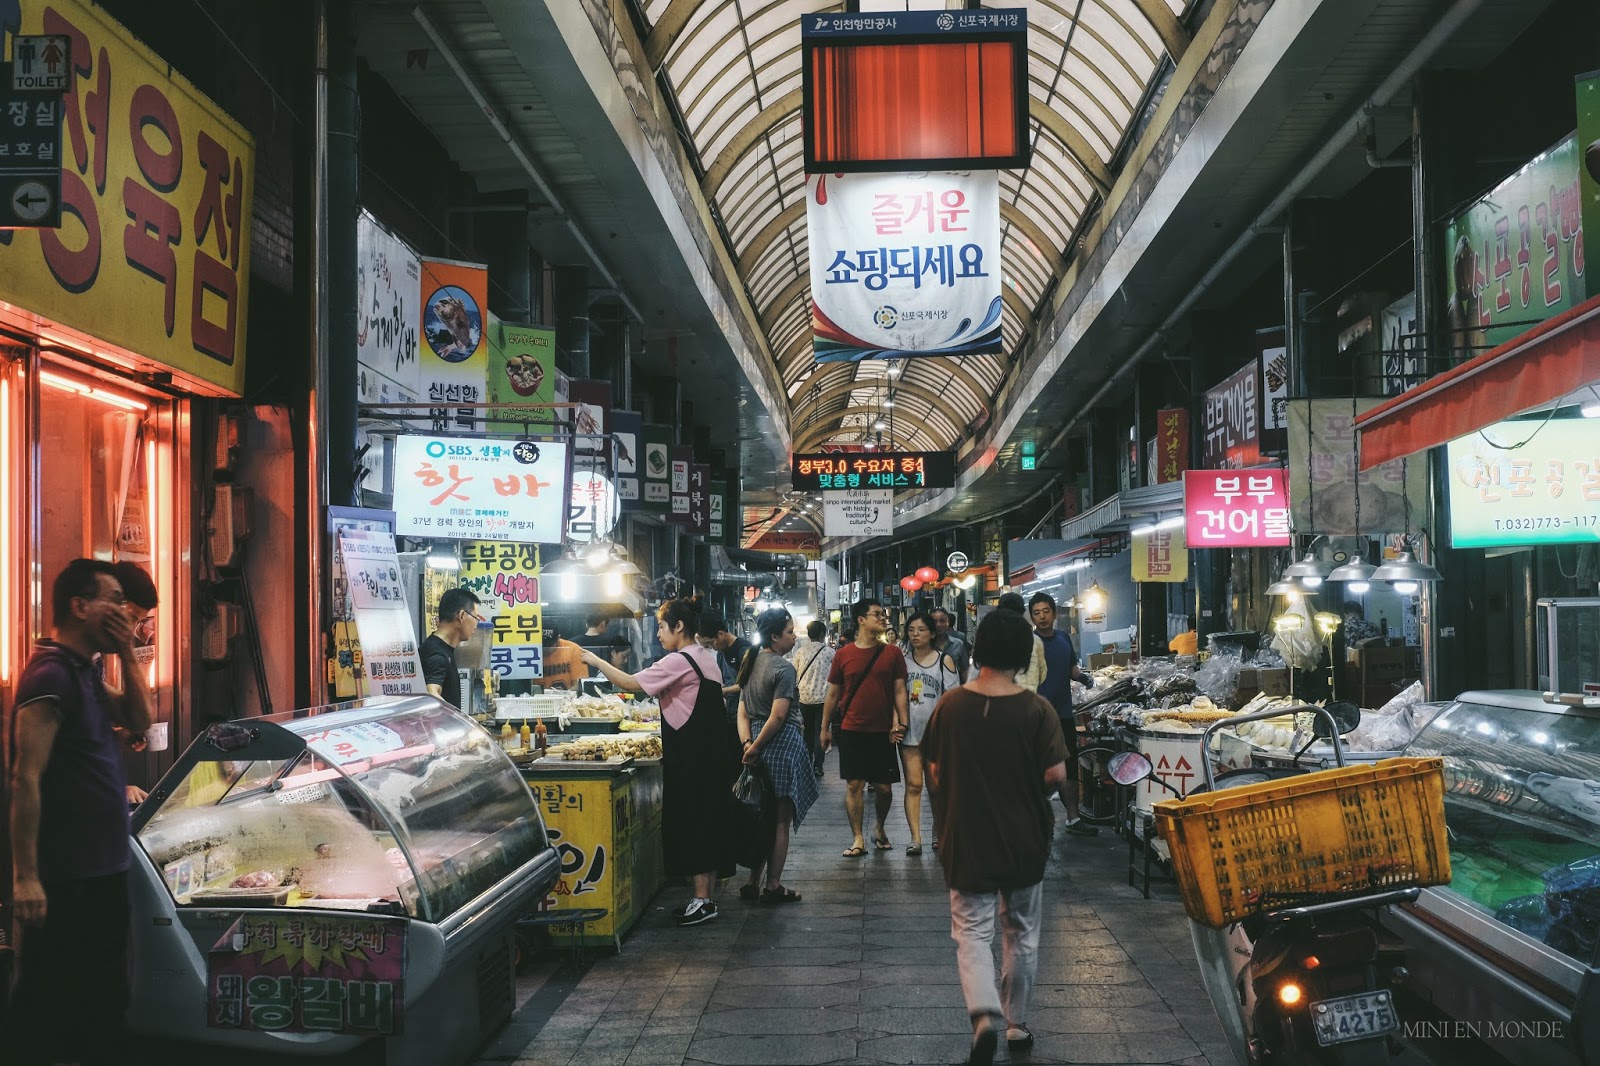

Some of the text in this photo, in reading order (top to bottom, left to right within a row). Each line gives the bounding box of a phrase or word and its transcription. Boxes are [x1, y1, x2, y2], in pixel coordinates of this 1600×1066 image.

[832, 18, 897, 31] 인천항만공사
[957, 14, 1019, 28] 신포국제시장
[16, 76, 63, 88] TOILET
[0, 101, 55, 127] 장실
[43, 5, 243, 366] 정육점
[872, 189, 970, 235] 즐거운
[1472, 171, 1585, 332] 신포공갈빵
[825, 243, 989, 291] 쇼핑되세요
[900, 309, 948, 321] 신포국제시장
[428, 382, 478, 403] 신선한
[448, 445, 511, 457] SBS 생활의
[514, 448, 537, 461] 달인
[798, 458, 847, 474] 정부3.0
[853, 459, 896, 472] 수요자
[819, 473, 860, 487] 맞춤형
[868, 473, 909, 487] 서비스
[1213, 475, 1276, 505] 부부
[412, 517, 432, 526] 37년
[437, 518, 453, 527] 경력
[458, 518, 483, 528] 장인의
[508, 520, 535, 530] 개발자
[1196, 508, 1291, 538] 건어물
[1495, 515, 1600, 531] T.032)773-117
[460, 543, 538, 572] 두부공장
[493, 572, 539, 607] 식혜
[491, 614, 540, 643] 두부
[490, 646, 541, 677] 콩국
[216, 974, 394, 1035] 돼지 왕갈비
[1338, 1008, 1391, 1035] 4275
